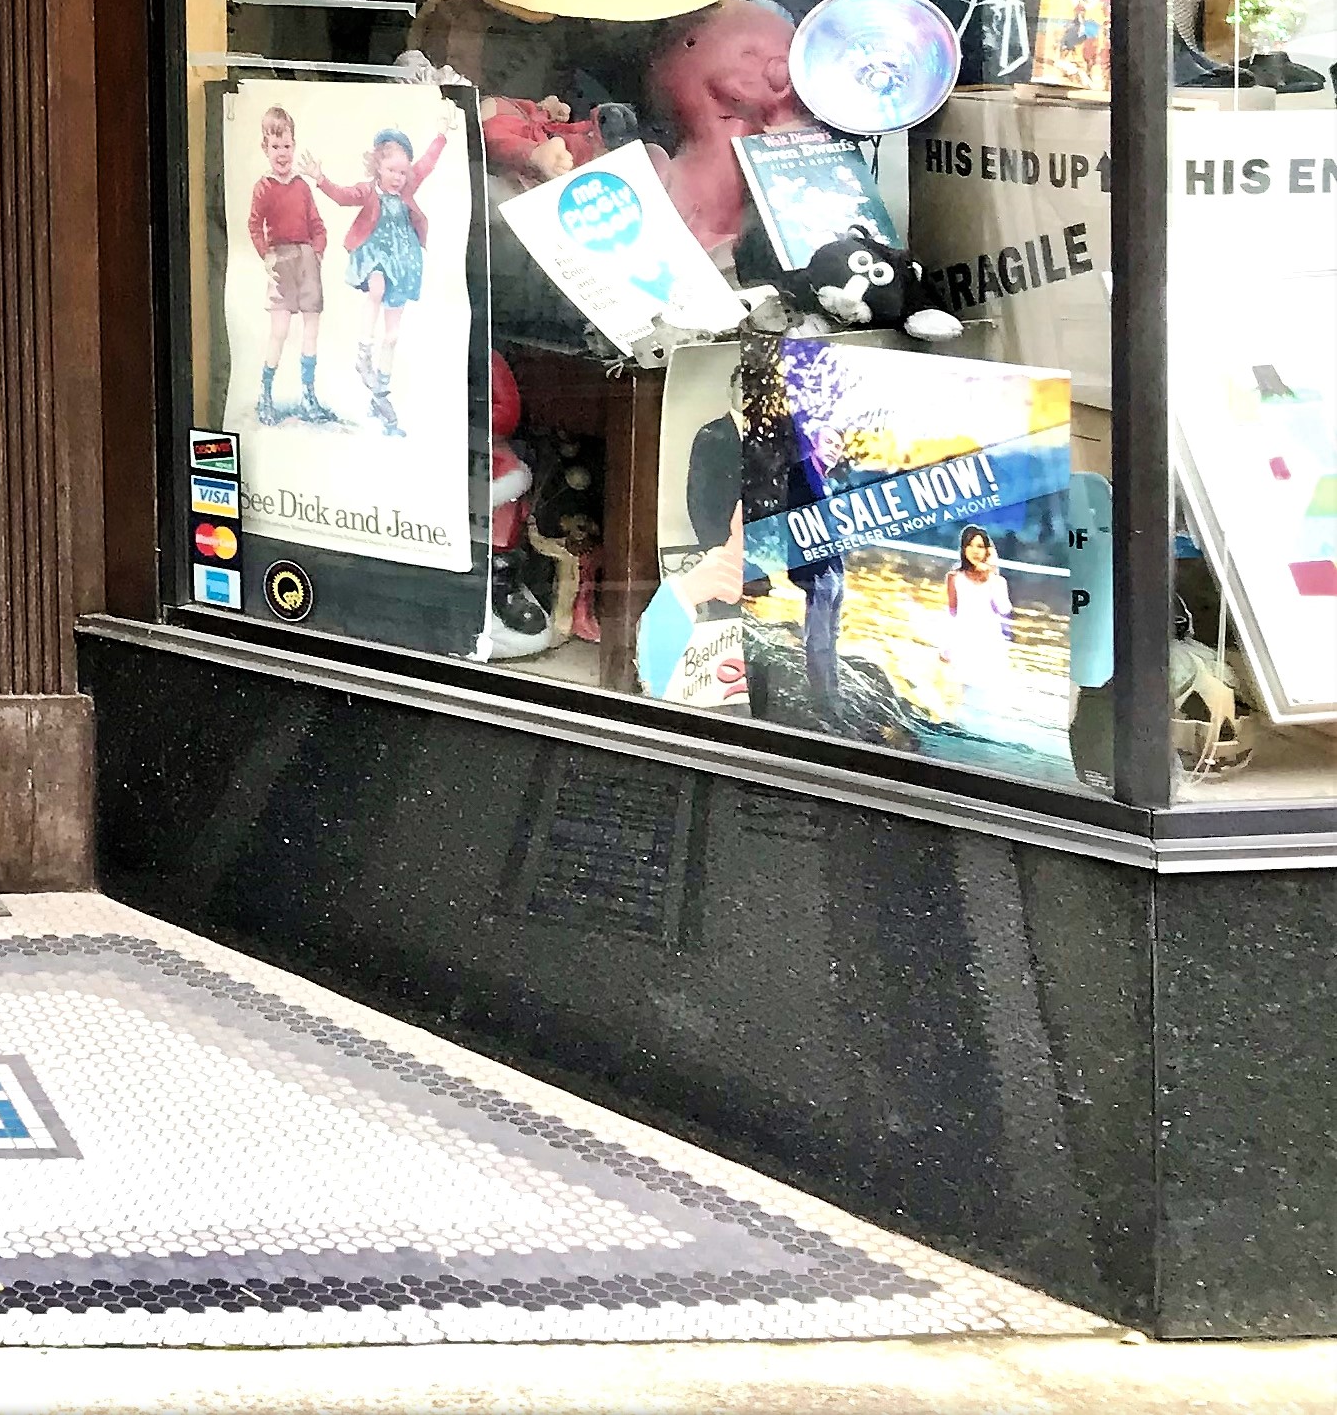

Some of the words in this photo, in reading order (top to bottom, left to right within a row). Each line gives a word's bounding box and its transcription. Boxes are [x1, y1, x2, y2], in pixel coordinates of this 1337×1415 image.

[750, 148, 800, 163] Seven
[799, 139, 855, 155] Dwarfs
[762, 136, 789, 147] Walt
[789, 132, 832, 144] Disney's
[926, 139, 972, 177] HIS
[981, 146, 1039, 185] END
[1049, 152, 1089, 189] UP
[1186, 157, 1271, 197] HIS
[562, 186, 633, 229] PIGGLY
[199, 488, 230, 505] VISA
[787, 506, 831, 548] ON
[828, 481, 909, 536] SALE
[907, 454, 999, 513] NOW!
[277, 488, 329, 525] Dick
[335, 502, 380, 536] and
[384, 509, 453, 549] Jane.
[802, 529, 884, 563] BESTSELLER
[886, 519, 901, 536] IS
[903, 514, 939, 533] NOW
[943, 510, 954, 522] A
[955, 494, 1001, 518] MOVIE
[682, 668, 711, 700] with
